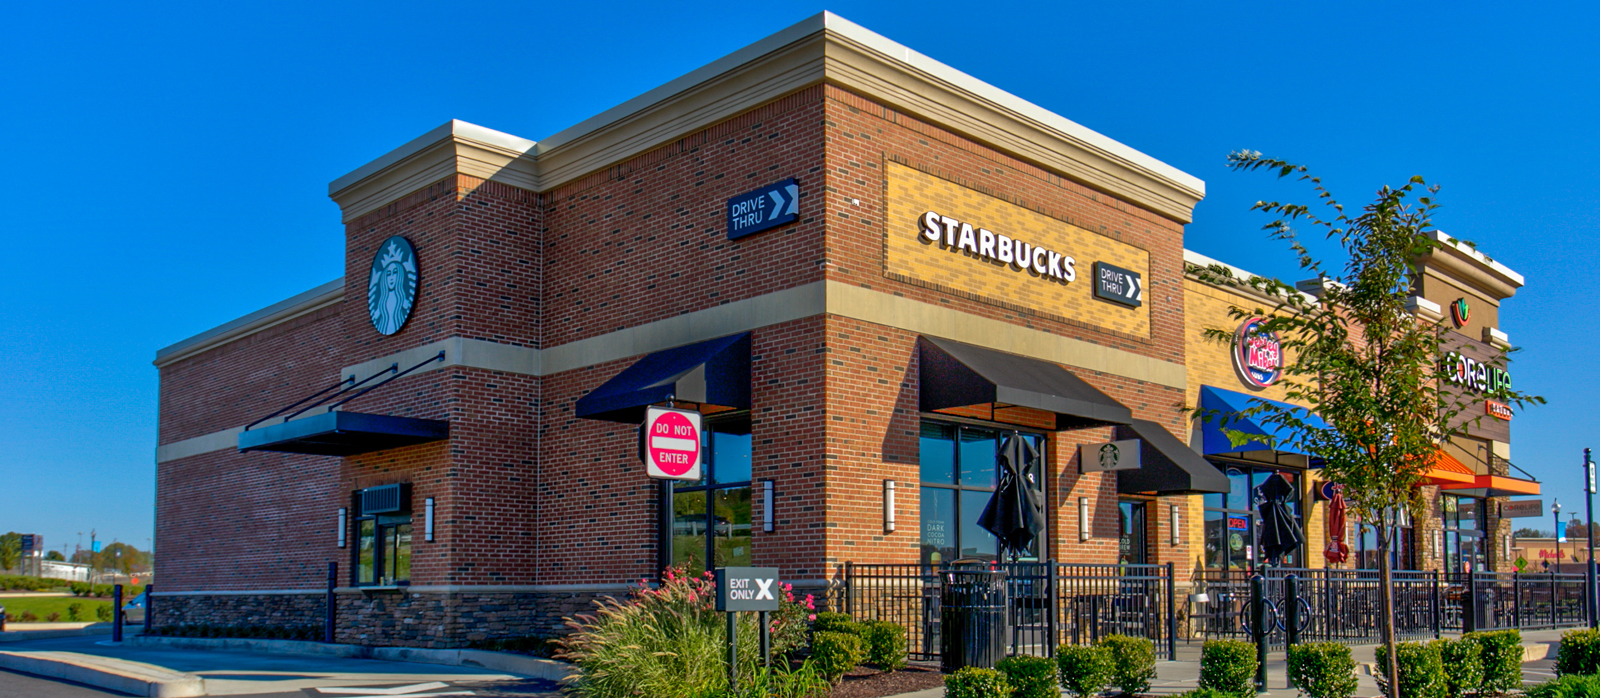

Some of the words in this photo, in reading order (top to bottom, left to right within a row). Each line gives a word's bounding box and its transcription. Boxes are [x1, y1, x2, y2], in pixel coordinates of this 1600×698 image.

[732, 195, 765, 217] DRIVE
[732, 210, 763, 230] THRU
[925, 211, 1076, 282] STARBUCKS
[1101, 268, 1123, 284] DRIVE
[1101, 280, 1122, 295] THRU
[656, 423, 669, 434] DO
[674, 425, 692, 436] NOT
[659, 452, 689, 464] ENTER
[927, 524, 945, 532] DARK
[1228, 518, 1246, 529] OPEN
[730, 578, 750, 589] EXIT
[730, 589, 755, 600] ONLY
